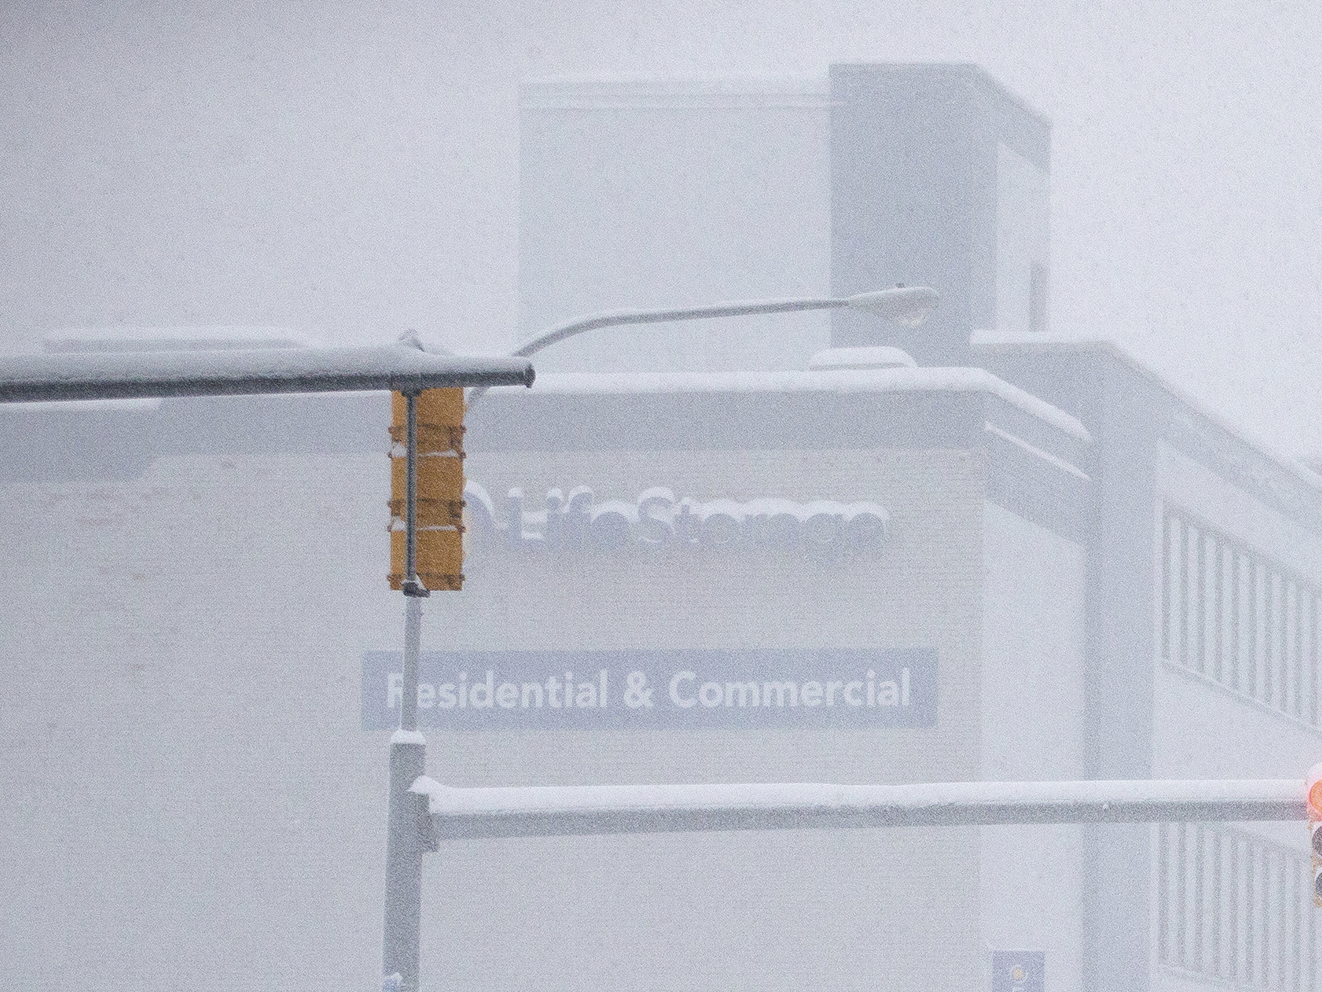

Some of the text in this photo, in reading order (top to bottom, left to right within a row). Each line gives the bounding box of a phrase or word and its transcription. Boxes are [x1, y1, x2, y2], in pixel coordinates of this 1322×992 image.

[386, 667, 911, 709] Residential & Commercial
